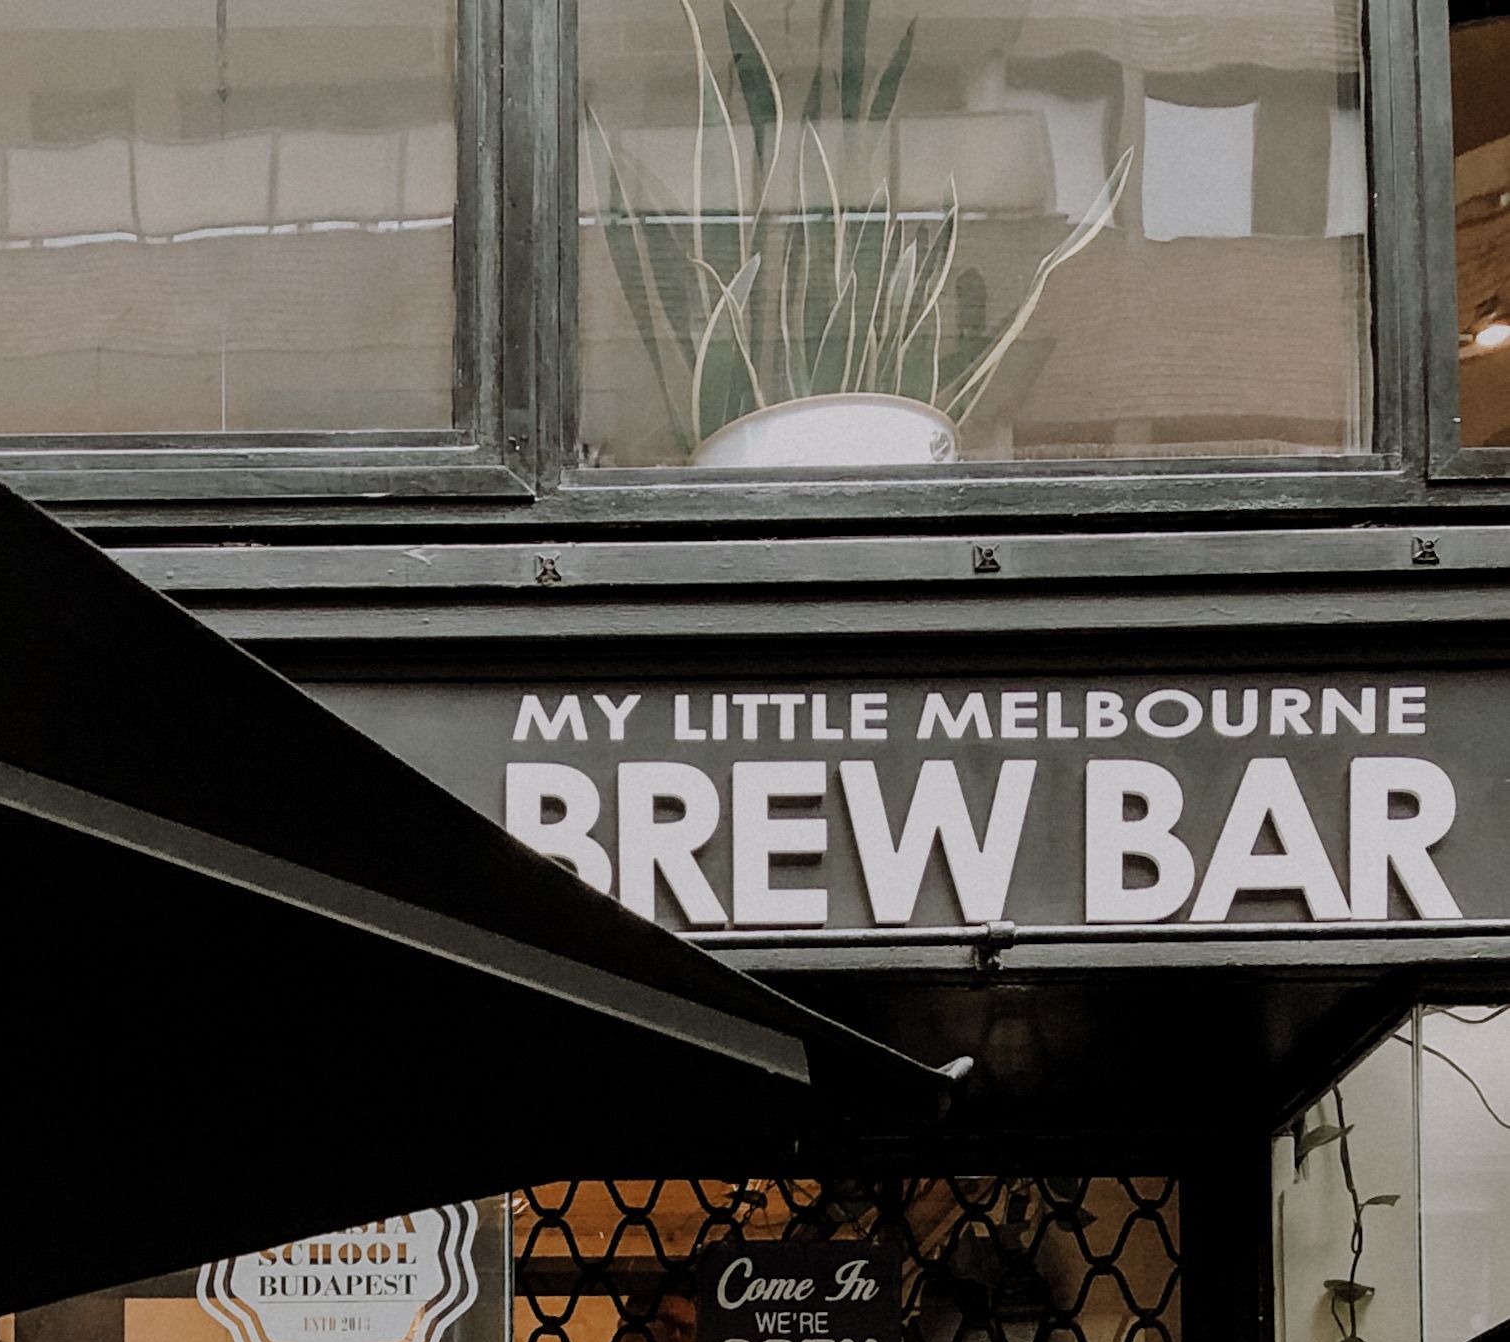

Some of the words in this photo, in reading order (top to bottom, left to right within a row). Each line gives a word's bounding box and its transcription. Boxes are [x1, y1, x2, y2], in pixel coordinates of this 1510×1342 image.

[513, 693, 643, 742] MY
[674, 691, 888, 741] LITTLE
[916, 686, 1428, 740] MELBOURNE
[505, 757, 1037, 929] BREW
[1086, 756, 1463, 926] BAR
[259, 1242, 417, 1267] SCHOOL
[259, 1275, 417, 1297] BUDAPEST
[717, 1257, 815, 1310] Come
[825, 1260, 879, 1301] In
[755, 1312, 829, 1334] WE'RE
